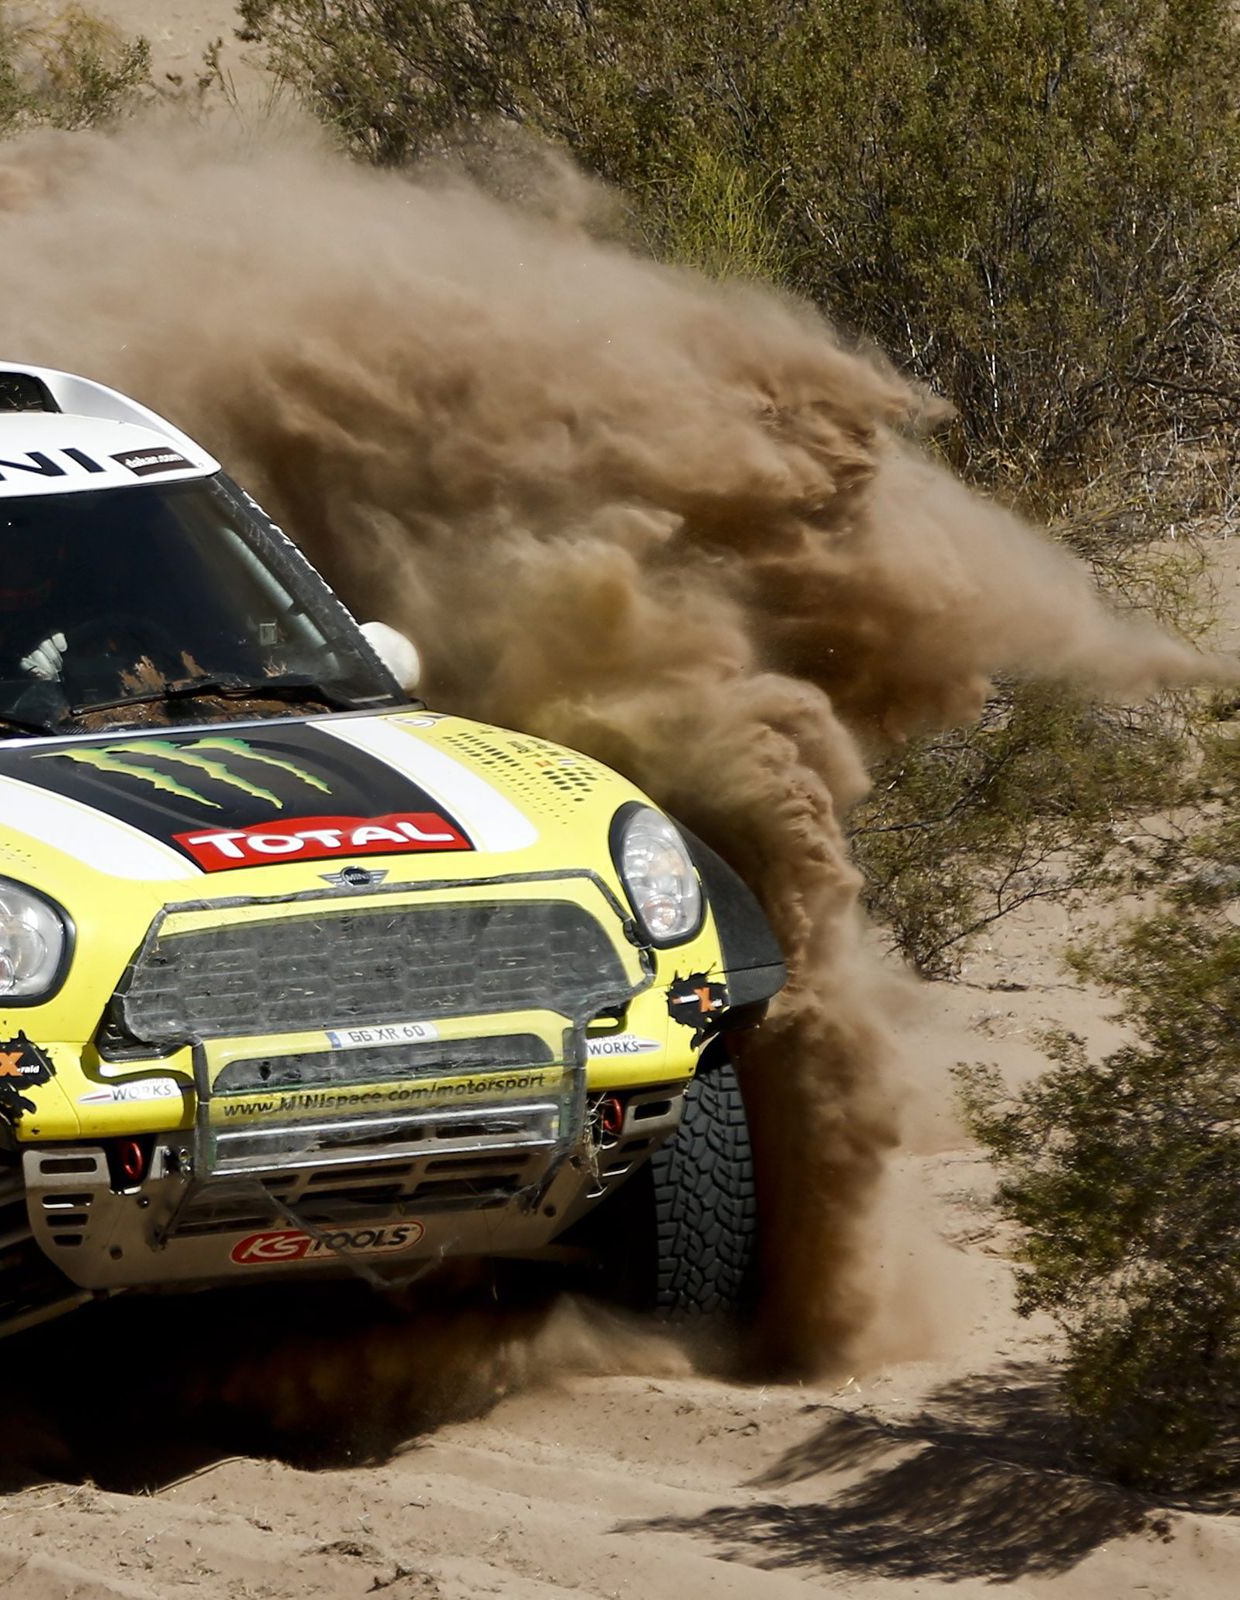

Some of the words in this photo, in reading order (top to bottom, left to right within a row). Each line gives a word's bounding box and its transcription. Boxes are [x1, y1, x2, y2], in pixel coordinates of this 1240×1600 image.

[188, 822, 455, 859] TOTAL
[349, 1030, 372, 1043] GG
[378, 1028, 400, 1041] XR
[588, 1041, 640, 1056] WORKS
[224, 1072, 546, 1117] www.MINIspace.com/motorsport
[241, 1235, 312, 1260] KS
[313, 1226, 411, 1251] TOOLS
